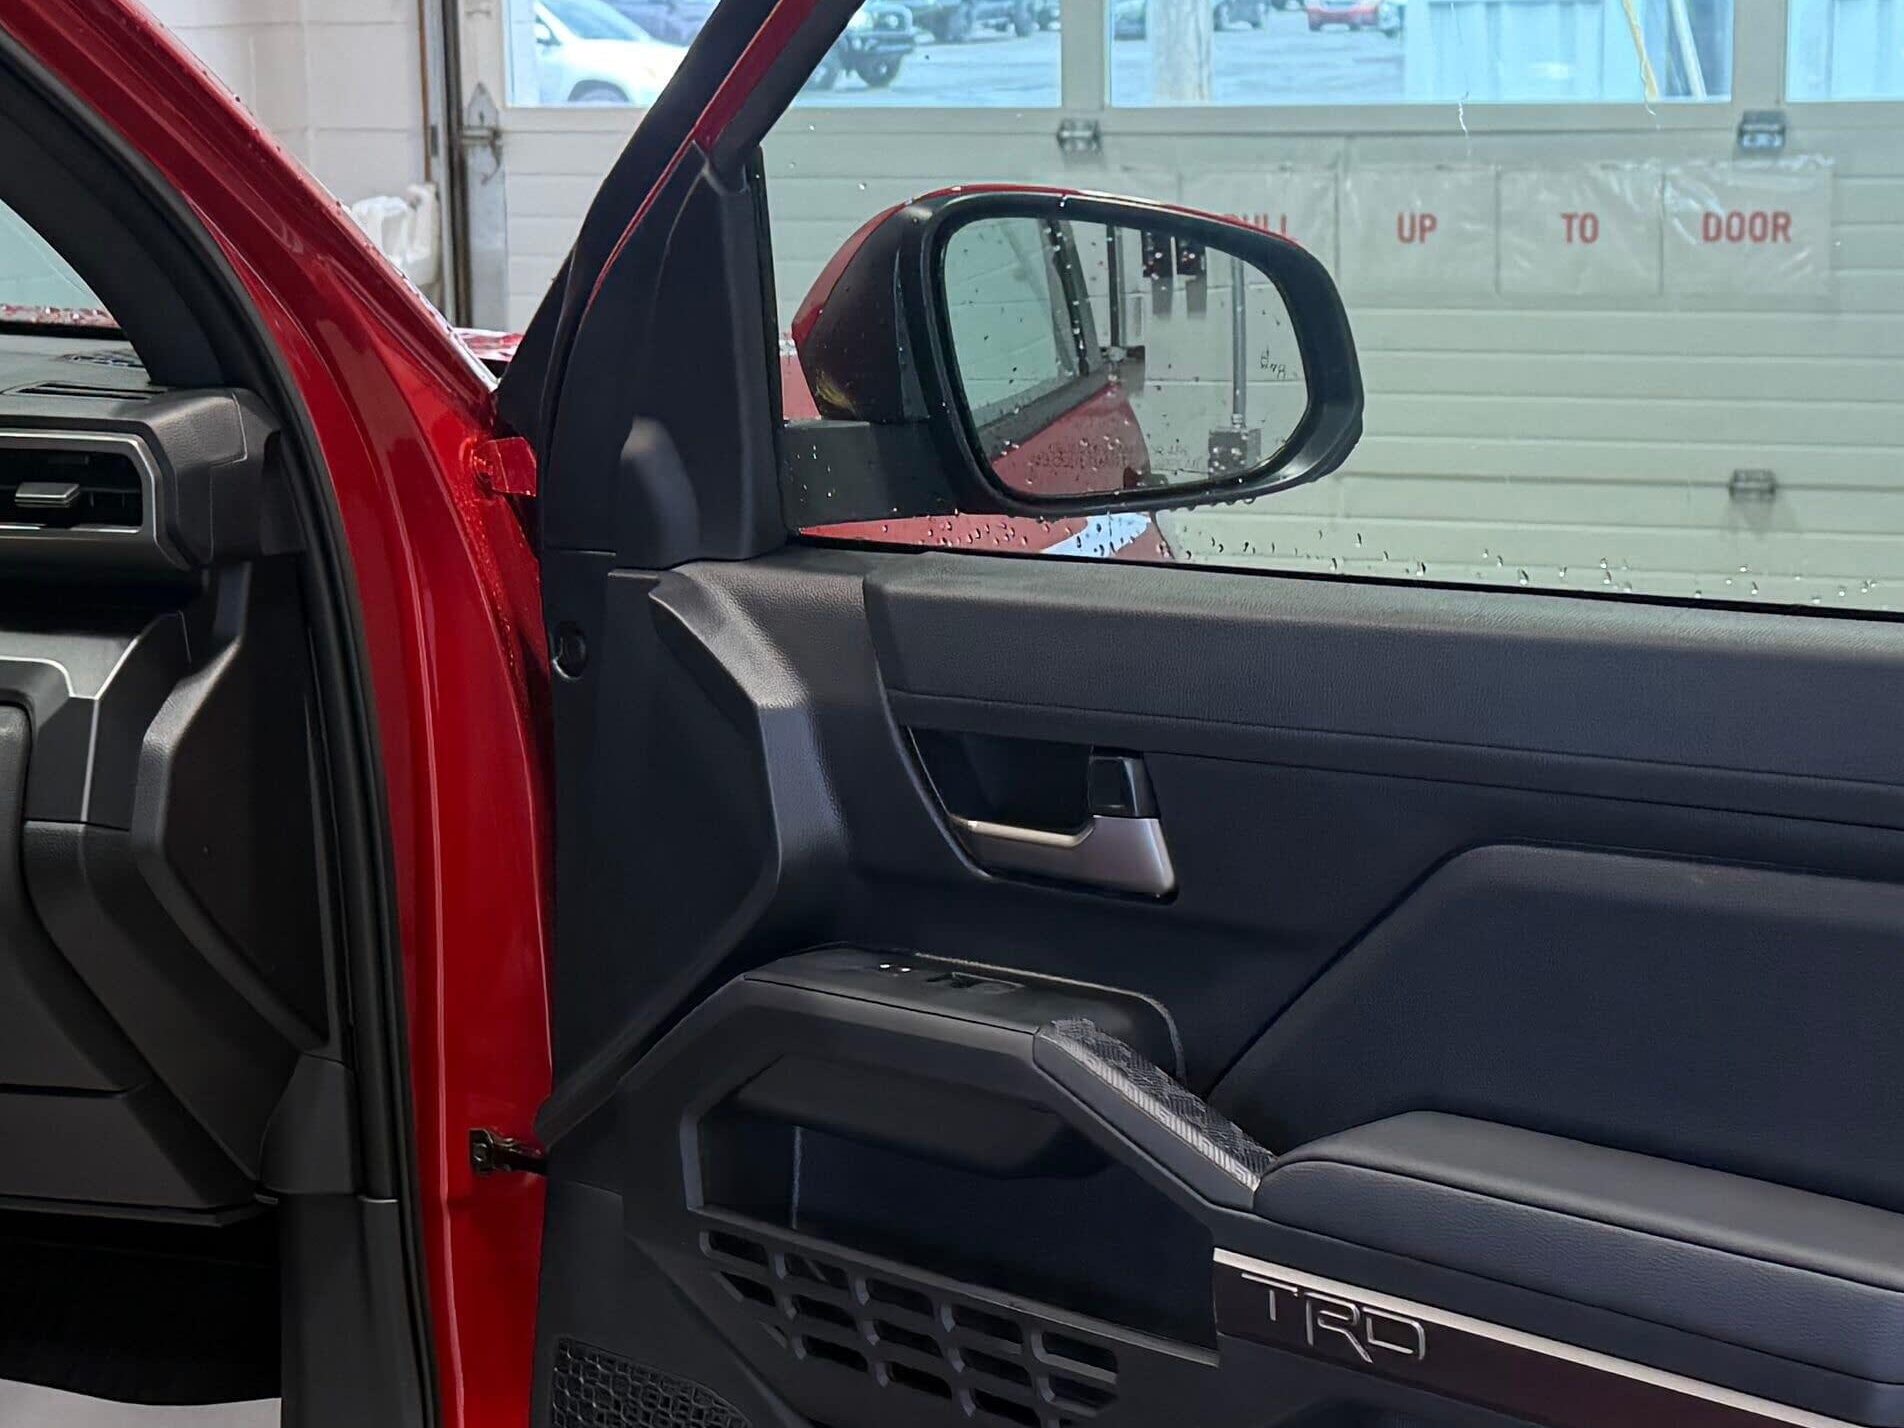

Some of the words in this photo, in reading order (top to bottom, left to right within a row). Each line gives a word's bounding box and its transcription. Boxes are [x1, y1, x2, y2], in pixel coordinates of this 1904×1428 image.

[1396, 212, 1438, 244] UP
[1560, 212, 1600, 245] TO
[1700, 211, 1793, 245] DOOR
[1241, 1272, 1427, 1364] TRD
